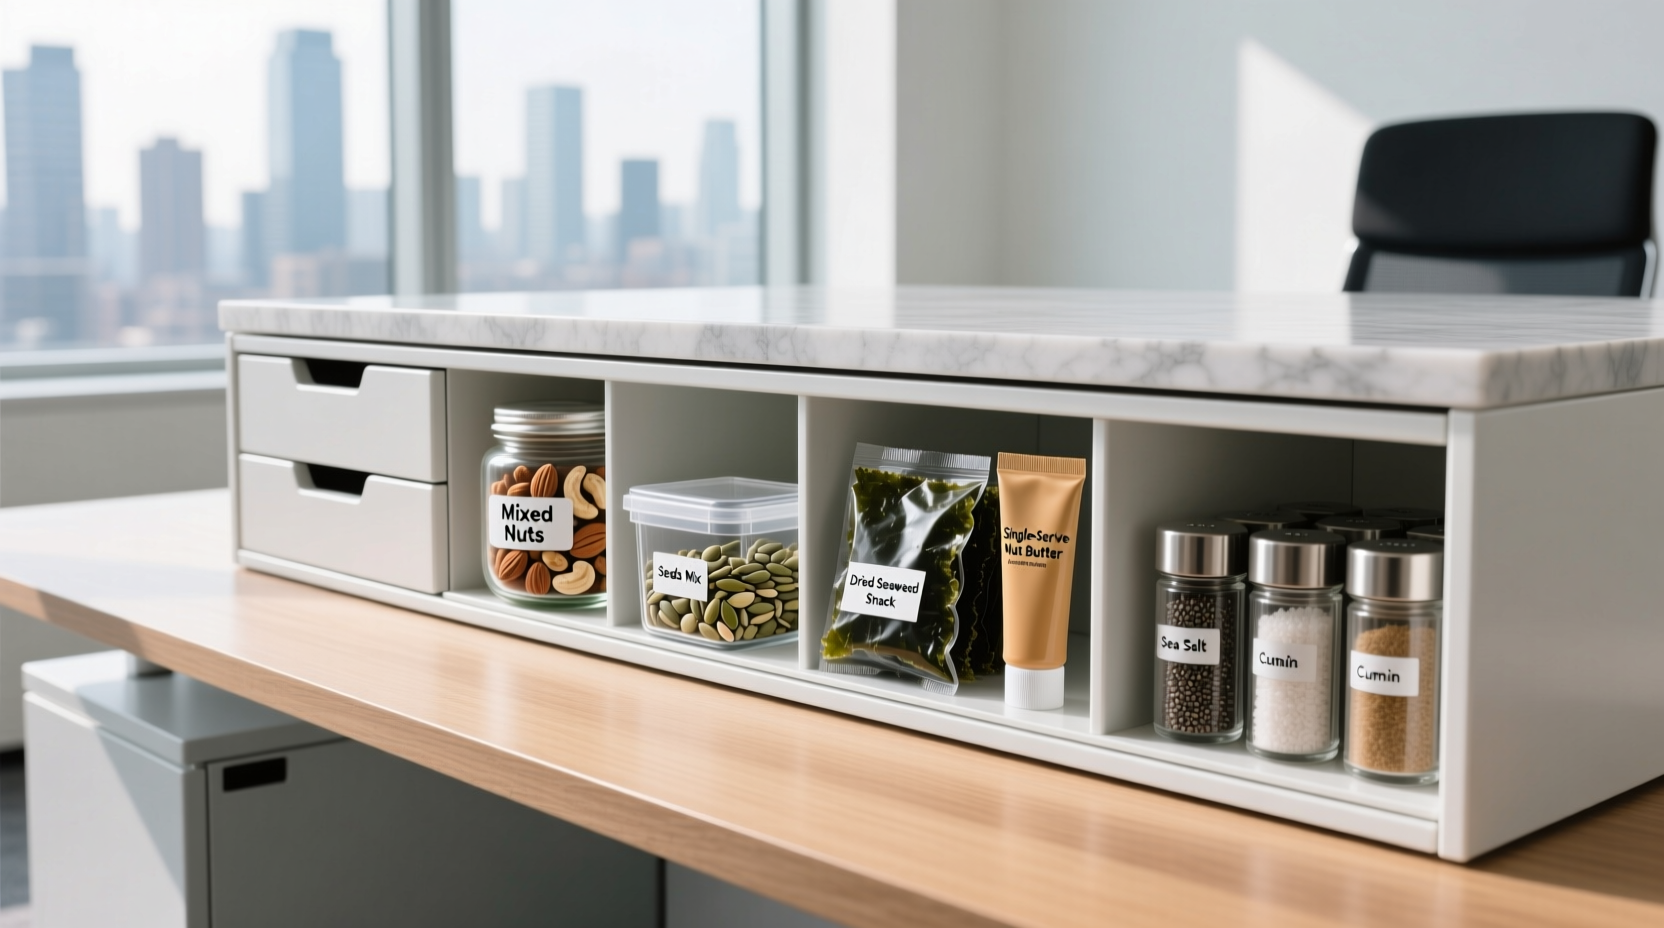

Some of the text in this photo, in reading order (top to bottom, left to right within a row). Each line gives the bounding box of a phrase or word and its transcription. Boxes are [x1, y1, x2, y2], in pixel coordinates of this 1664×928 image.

[502, 503, 553, 523] Mixed
[505, 524, 544, 543] Nuts
[1026, 545, 1063, 560] Butter
[876, 577, 920, 594] Seaweed
[865, 592, 896, 609] Snack
[1161, 636, 1207, 653] Sea Salt
[1259, 651, 1298, 669] Cumin
